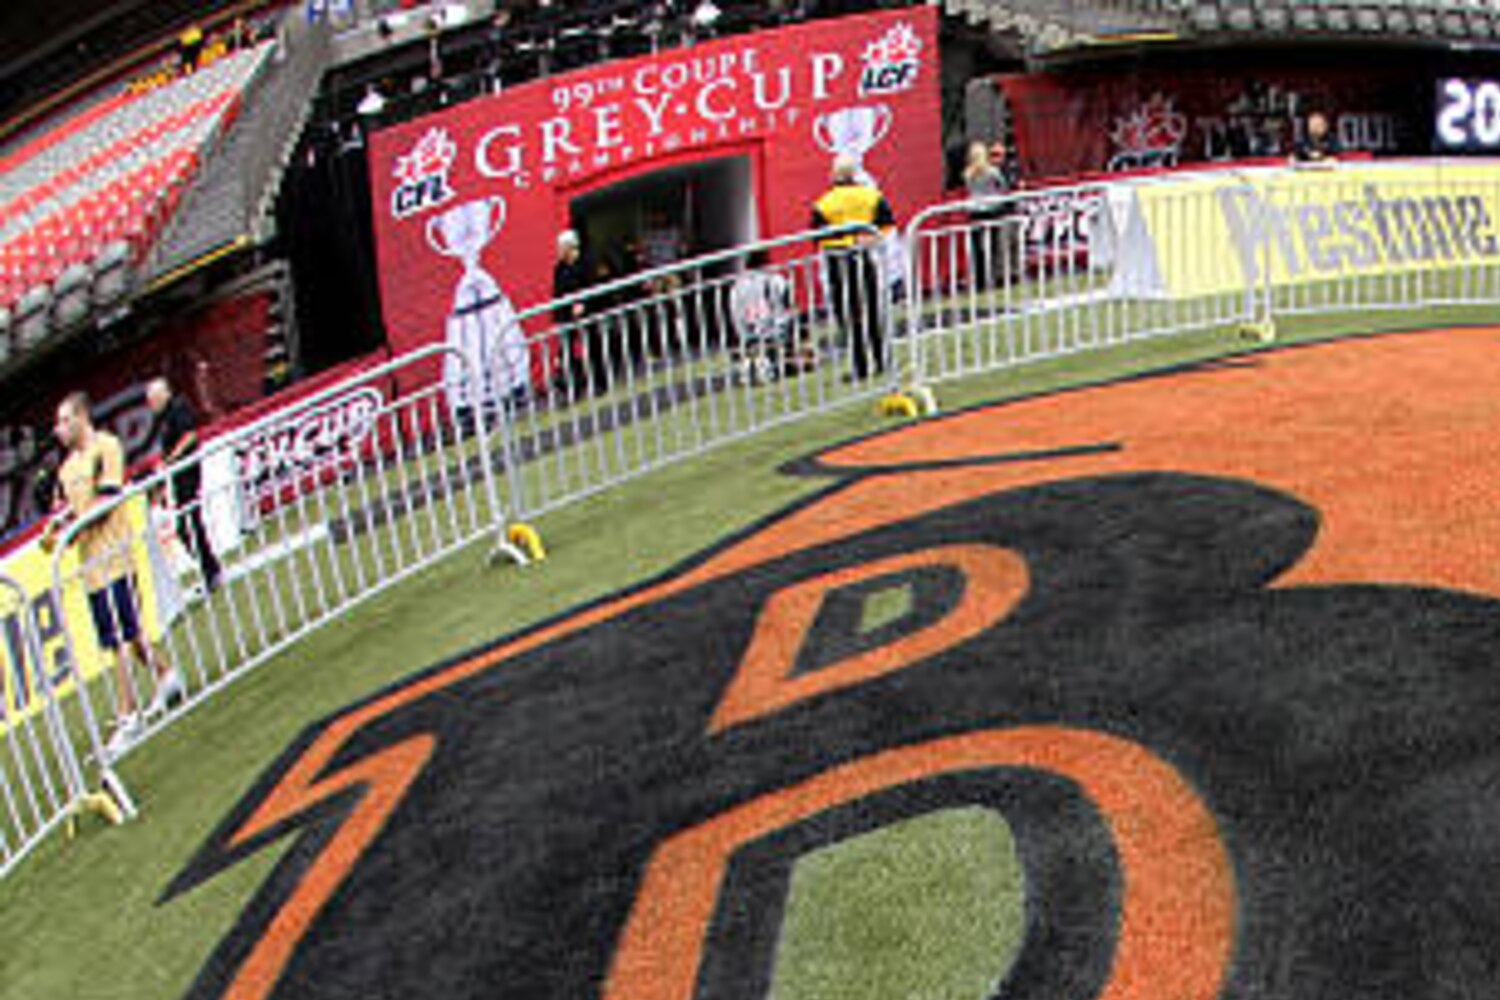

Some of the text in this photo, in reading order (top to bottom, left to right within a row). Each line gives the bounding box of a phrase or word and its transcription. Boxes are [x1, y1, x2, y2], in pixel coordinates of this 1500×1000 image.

[633, 48, 762, 94] COUPE
[474, 52, 843, 179] GREY CUP
